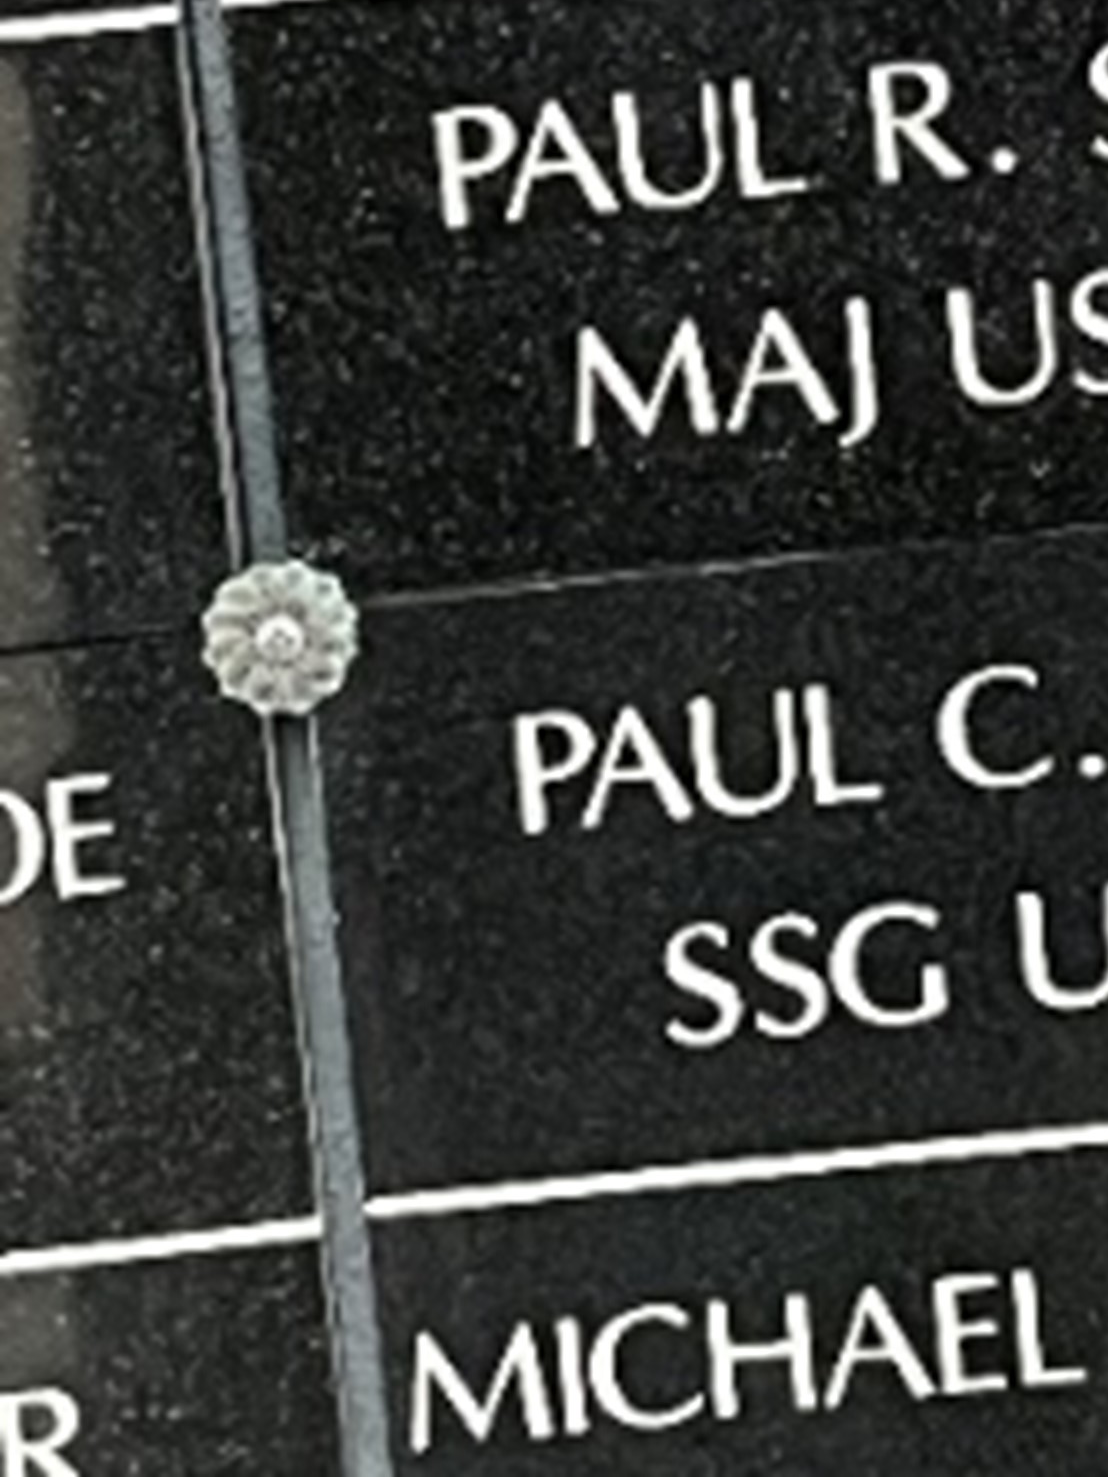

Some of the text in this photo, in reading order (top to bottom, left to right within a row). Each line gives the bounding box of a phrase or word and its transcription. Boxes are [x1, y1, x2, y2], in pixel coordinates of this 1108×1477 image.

[432, 77, 808, 229] PAUL
[868, 61, 1017, 184] R.
[576, 296, 878, 448] MAJ
[514, 684, 883, 836] PAUL
[937, 664, 1106, 789] C.
[664, 902, 949, 1047] SSG
[410, 1269, 1087, 1454] MICHAEL
